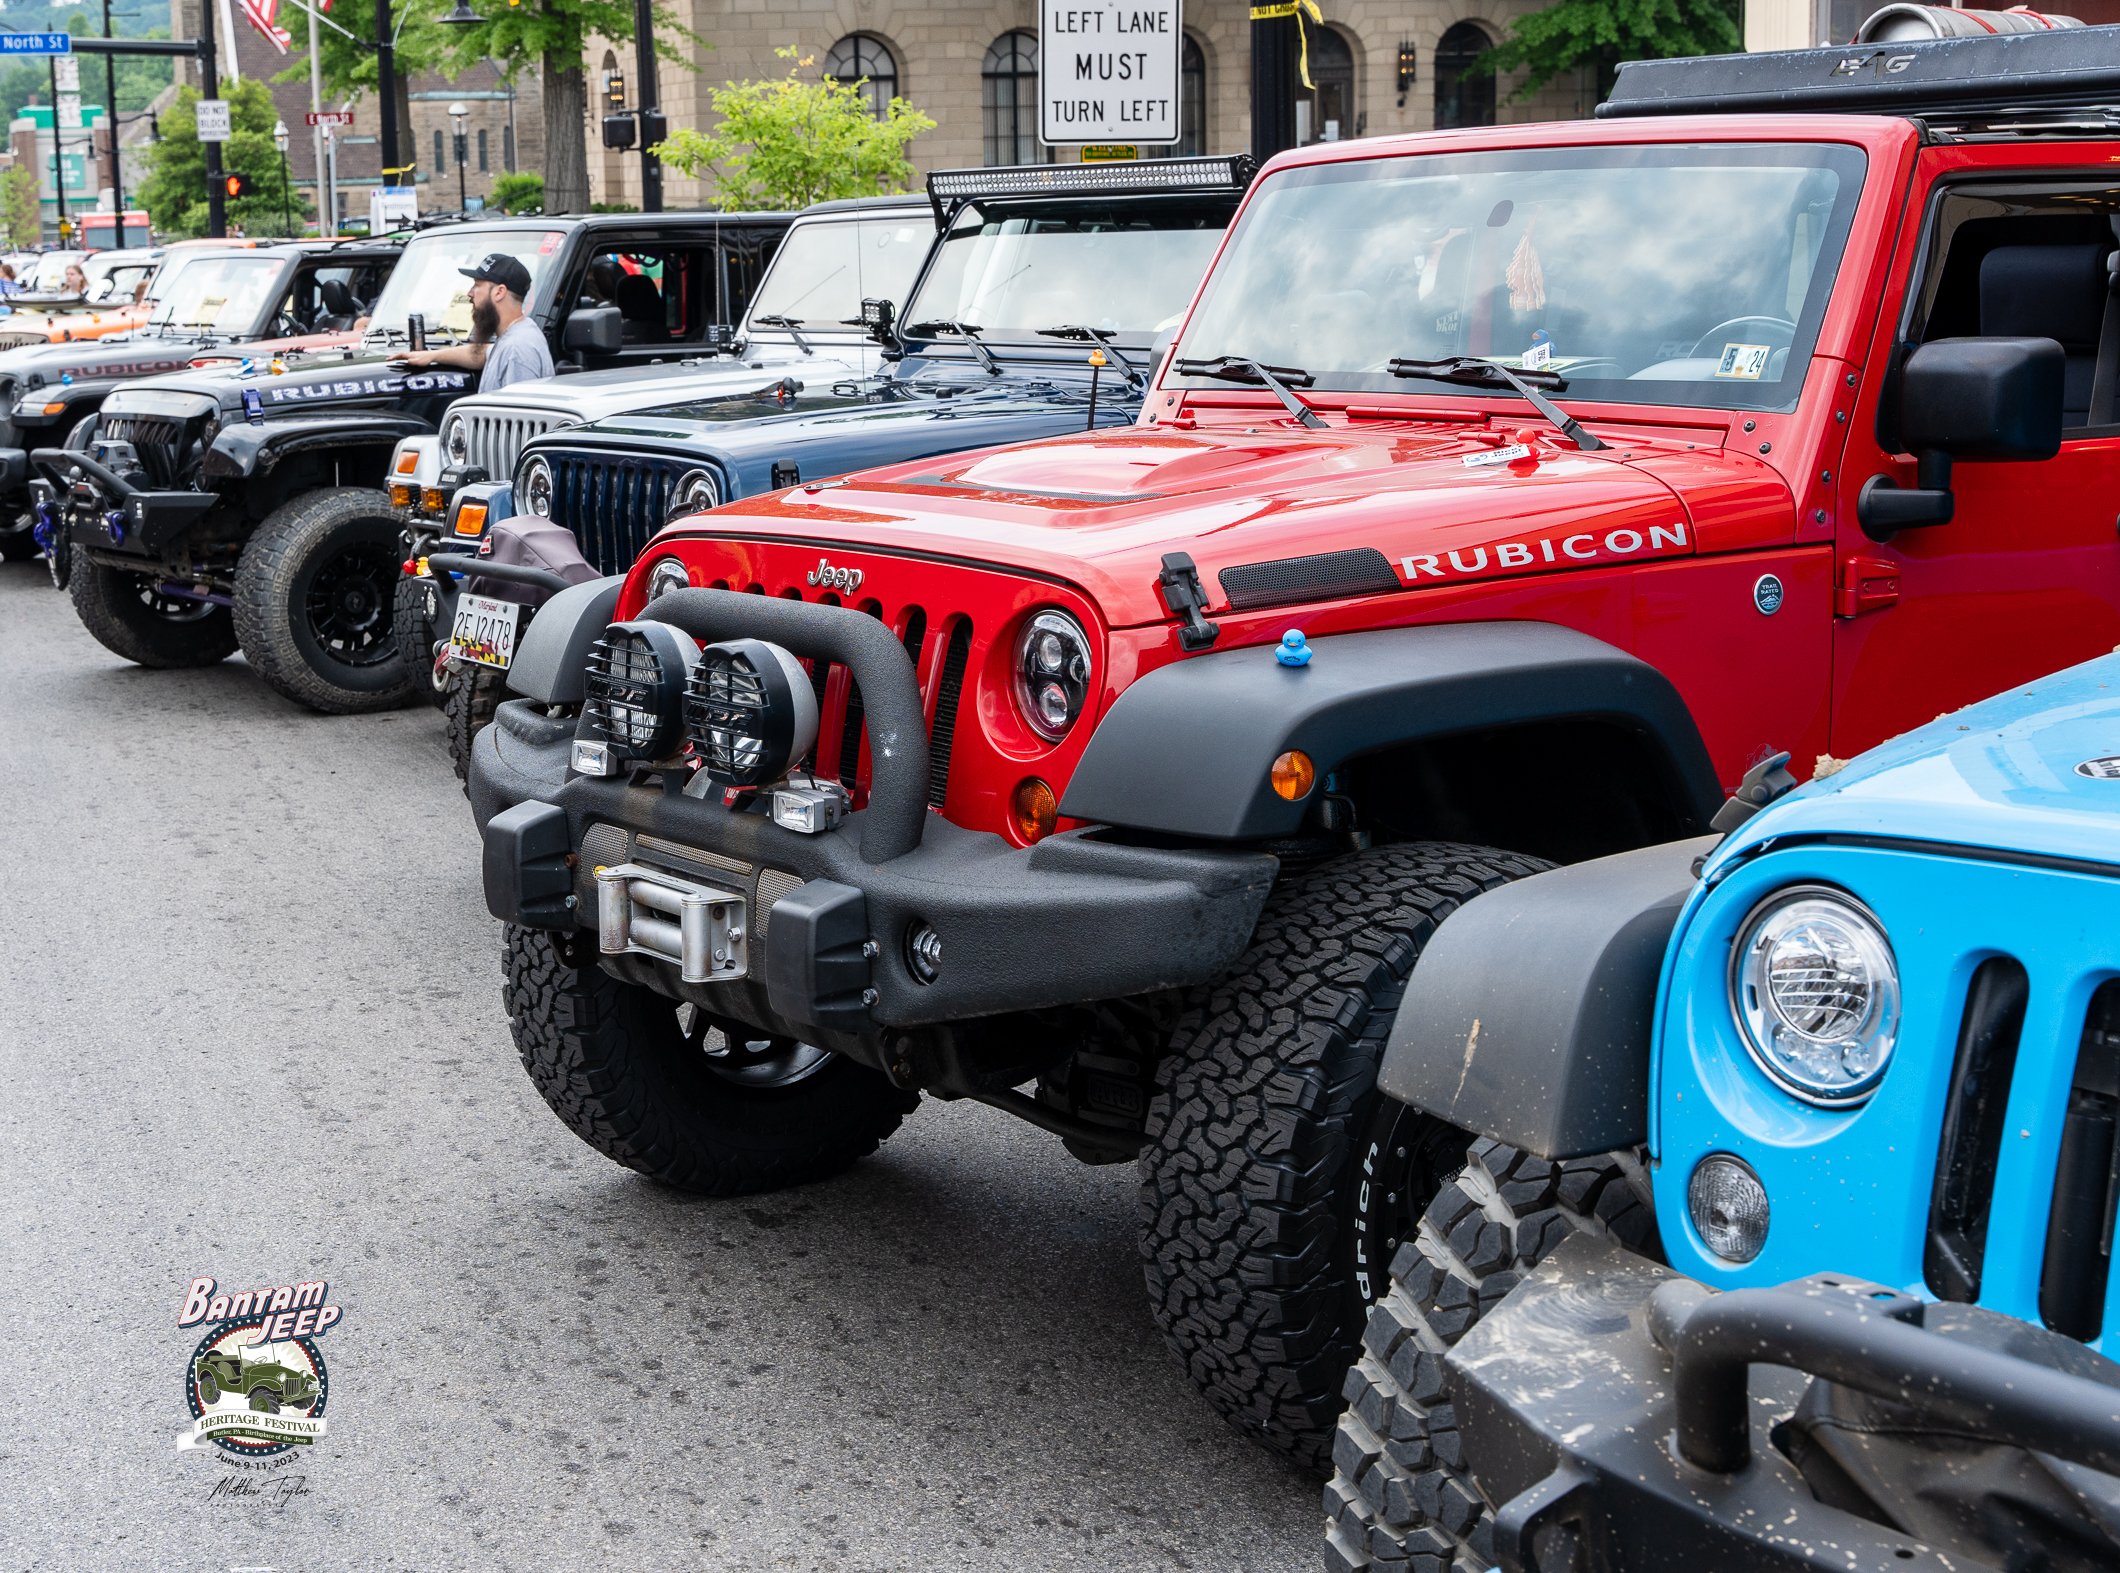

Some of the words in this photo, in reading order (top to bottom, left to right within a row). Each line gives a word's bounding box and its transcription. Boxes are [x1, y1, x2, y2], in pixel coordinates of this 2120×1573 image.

[1055, 11, 1104, 33] LEFT
[1117, 11, 1168, 33] LANE
[3, 35, 44, 49] North
[48, 35, 63, 49] St
[1076, 53, 1147, 80] MUST
[1052, 100, 1104, 122] TURN
[1120, 100, 1168, 122] LEFT
[1725, 348, 1738, 371] 5
[1748, 350, 1766, 373] 24
[272, 374, 466, 401] RUBICON
[1400, 523, 1687, 579] RUBICON
[807, 558, 863, 596] Jeep
[478, 600, 498, 615] Maryland
[454, 611, 512, 651] 2EJ2478
